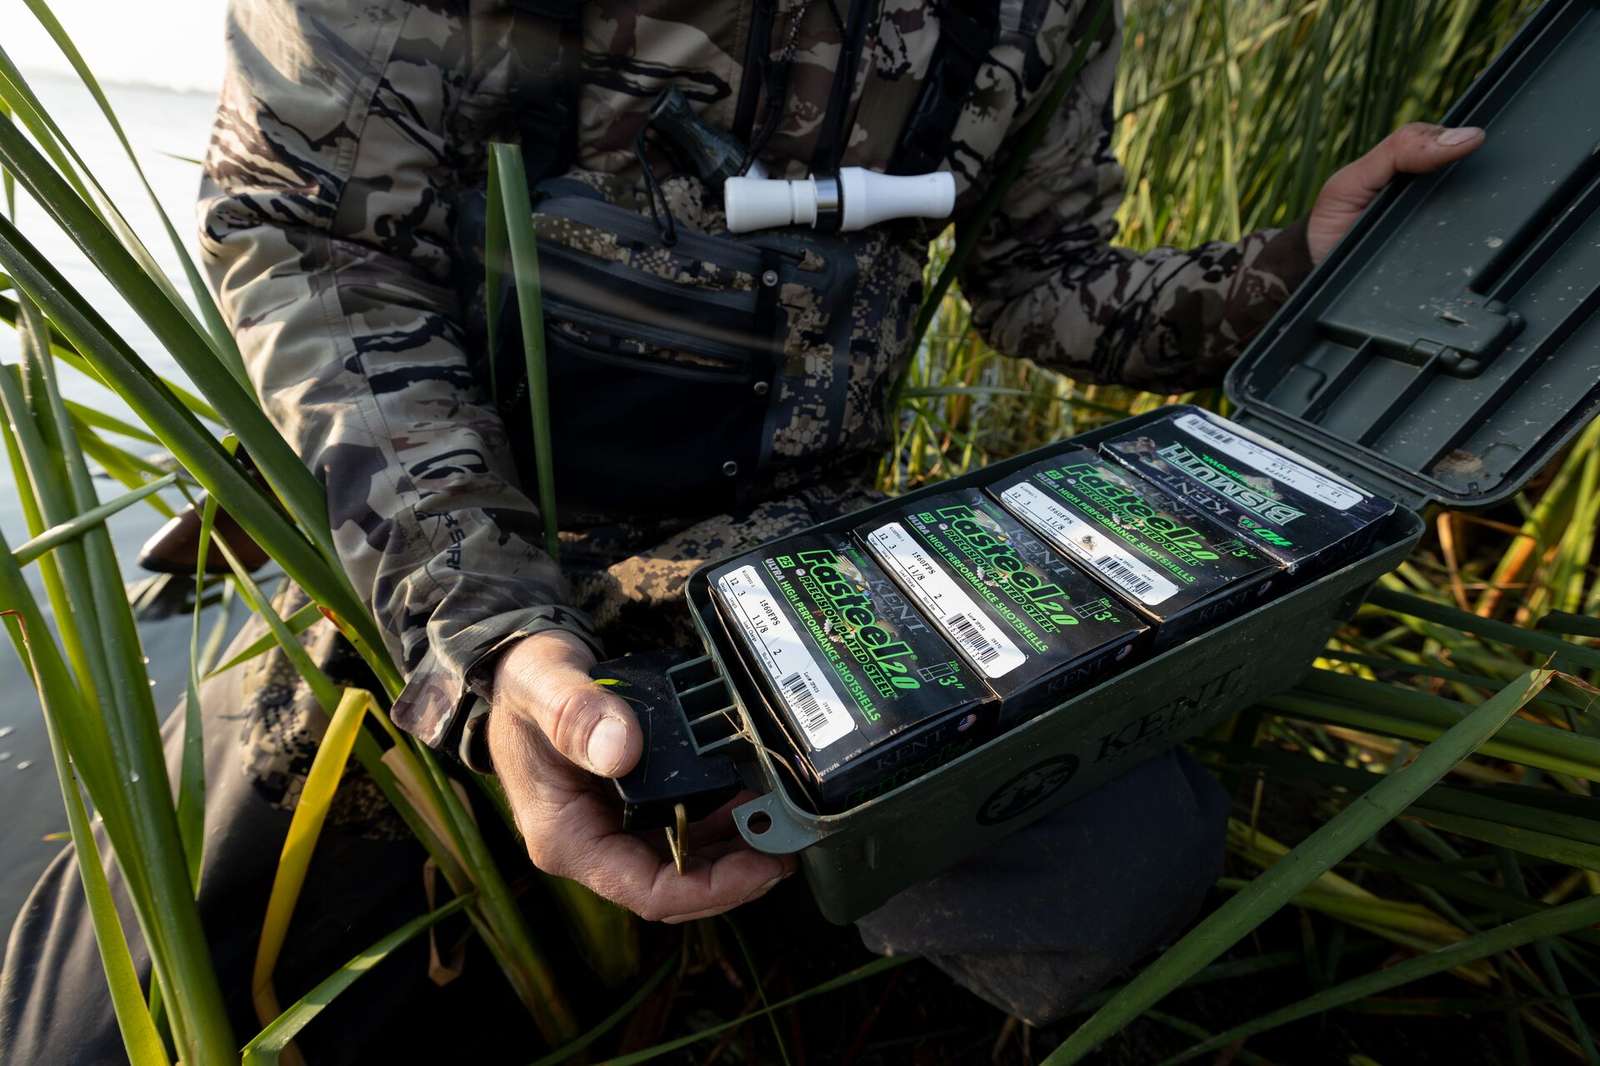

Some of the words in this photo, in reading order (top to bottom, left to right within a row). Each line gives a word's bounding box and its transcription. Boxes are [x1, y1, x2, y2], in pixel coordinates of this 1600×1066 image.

[1010, 491, 1022, 499] 12
[1062, 463, 1200, 541] Fasteel
[1180, 540, 1220, 561] 2.0
[1155, 441, 1299, 526] BISMUTH
[1157, 471, 1231, 515] KENT
[877, 531, 889, 541] 12
[887, 542, 898, 551] 3
[909, 568, 926, 582] 1/8
[932, 592, 943, 600] 2
[910, 550, 937, 575] 1560FPS
[936, 505, 1067, 603] Fasteel
[1035, 601, 1079, 626] 2.0
[1008, 528, 1075, 577] KENT
[1056, 486, 1083, 504] HIGH
[1076, 501, 1140, 543] PERFORMANCE
[1134, 541, 1199, 584] SHOTSHELLS
[1159, 540, 1203, 568] STEEL
[728, 575, 740, 587] 12
[735, 589, 746, 598] 3
[753, 618, 769, 635] 1/8
[771, 647, 782, 656] 2
[758, 597, 782, 627] 1560FPS
[798, 549, 916, 662] Fasteel
[882, 661, 921, 690] 2.0
[868, 578, 929, 637] KENT
[905, 513, 931, 535] ULTRA
[925, 533, 949, 553] HIGH
[943, 550, 1000, 603] PERFORMANCE
[993, 600, 1051, 653] SHOTSHELLS
[941, 527, 994, 573] PRECISION
[985, 570, 1028, 606] PLATED
[1019, 600, 1059, 634] STEEL
[1094, 609, 1121, 625] 3"
[763, 556, 786, 581] ULTRA
[779, 579, 801, 602] HIGH
[794, 601, 842, 662] PERFORMANCE
[833, 660, 884, 723] SHOTSHELLS
[797, 573, 844, 626] PRECISION
[834, 624, 872, 665] PLATED
[860, 661, 897, 700] STEEL
[939, 676, 966, 690] 3"
[1095, 664, 1244, 763] KENT
